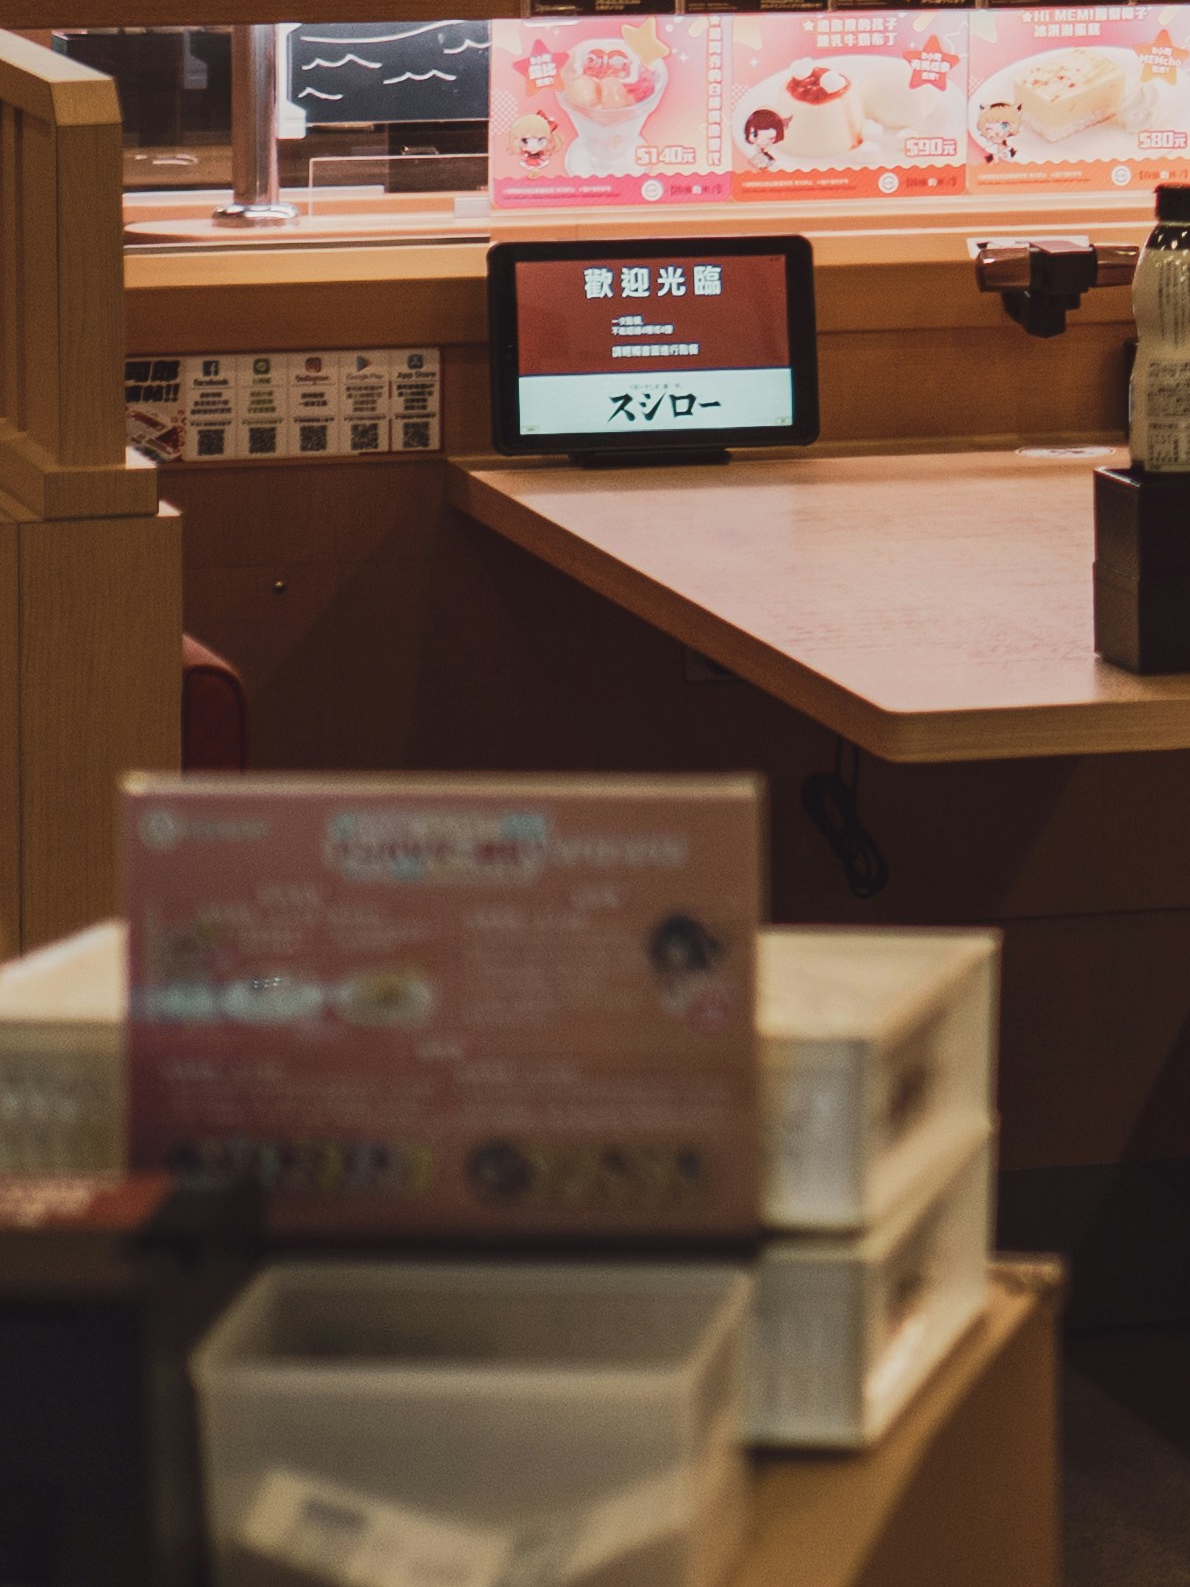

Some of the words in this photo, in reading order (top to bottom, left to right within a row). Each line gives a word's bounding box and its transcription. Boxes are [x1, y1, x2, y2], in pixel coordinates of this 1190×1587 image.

[583, 266, 722, 299] 歡迎光臨
[607, 392, 722, 424] スシロー
